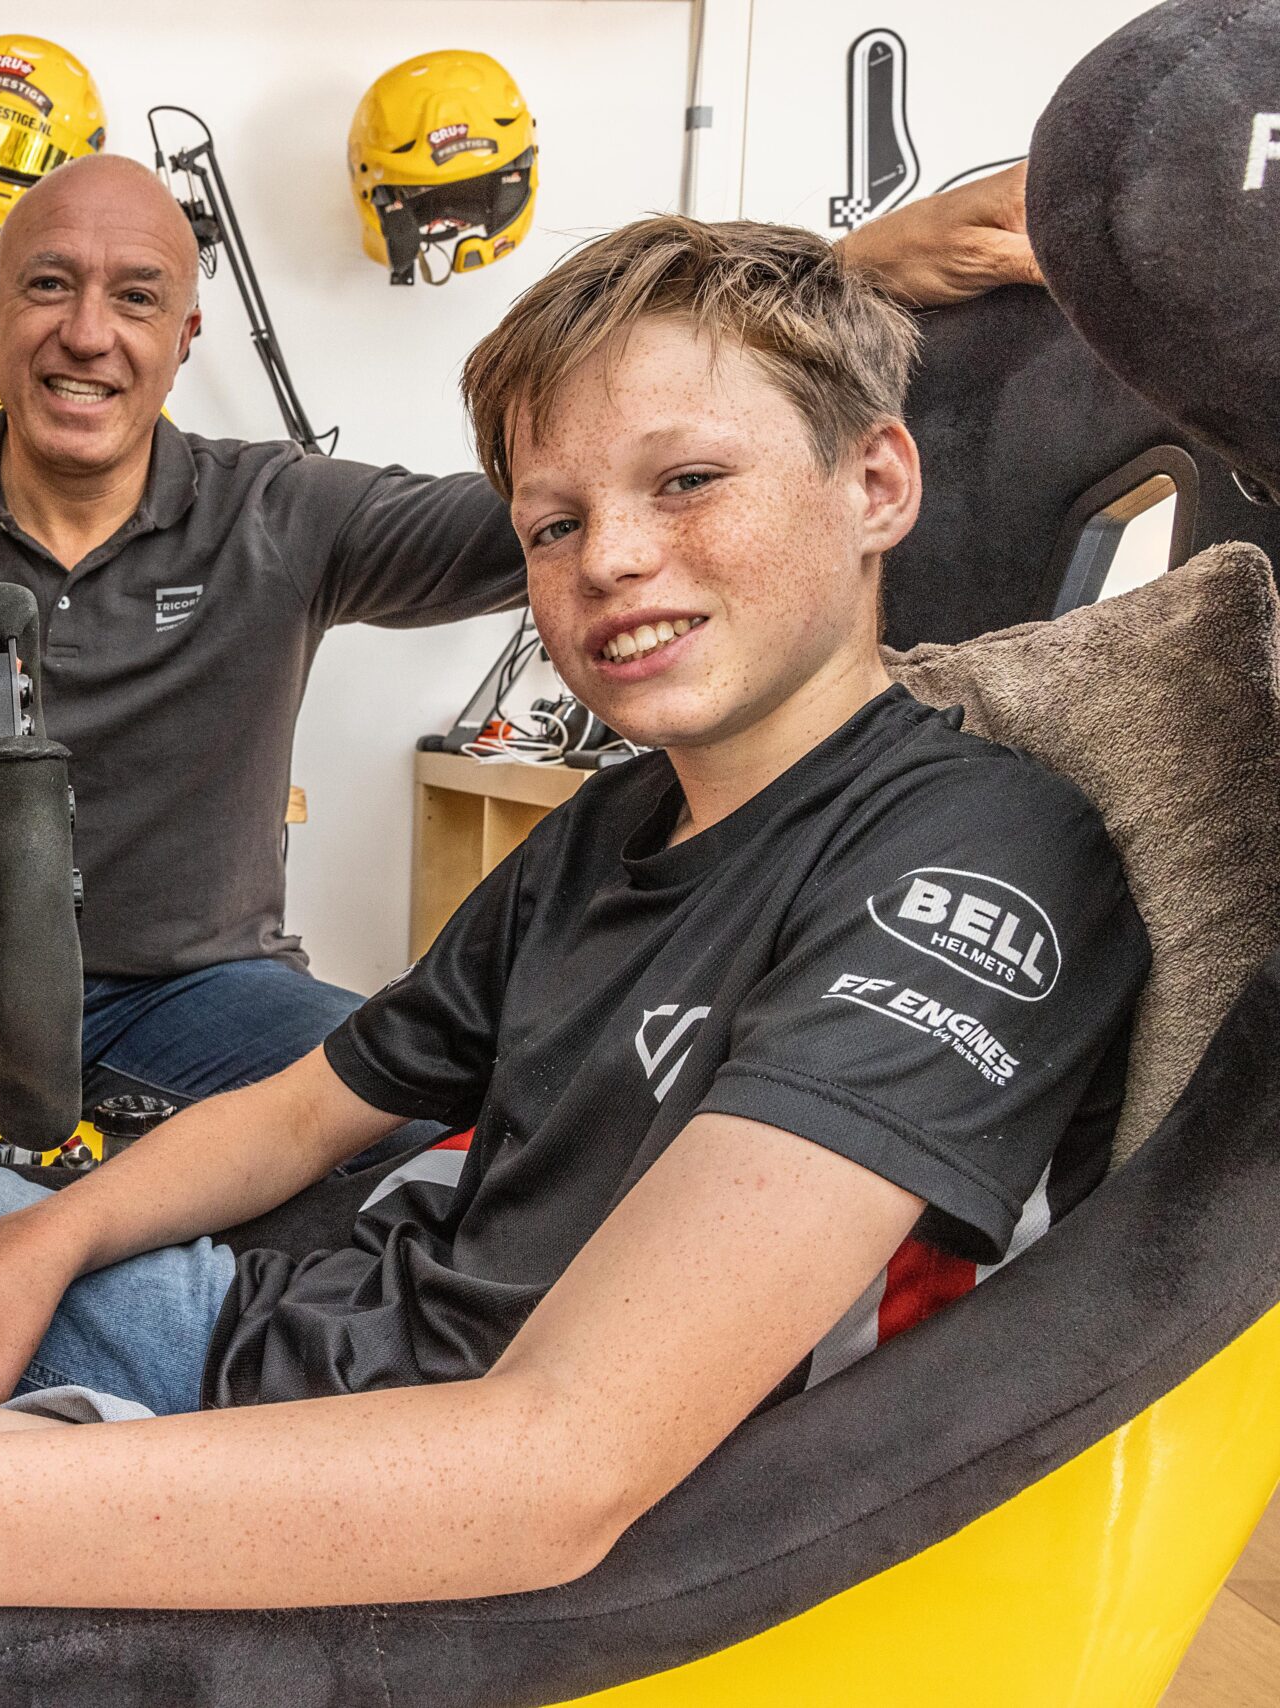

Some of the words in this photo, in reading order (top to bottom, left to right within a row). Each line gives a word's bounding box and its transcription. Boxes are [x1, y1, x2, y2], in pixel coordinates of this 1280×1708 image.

[438, 139, 489, 158] PRESTIGE
[897, 877, 1045, 986] BELL
[930, 931, 1017, 983] HELMETS
[827, 973, 897, 995] FF
[886, 987, 1021, 1079] ENGINES
[932, 1027, 953, 1044] by
